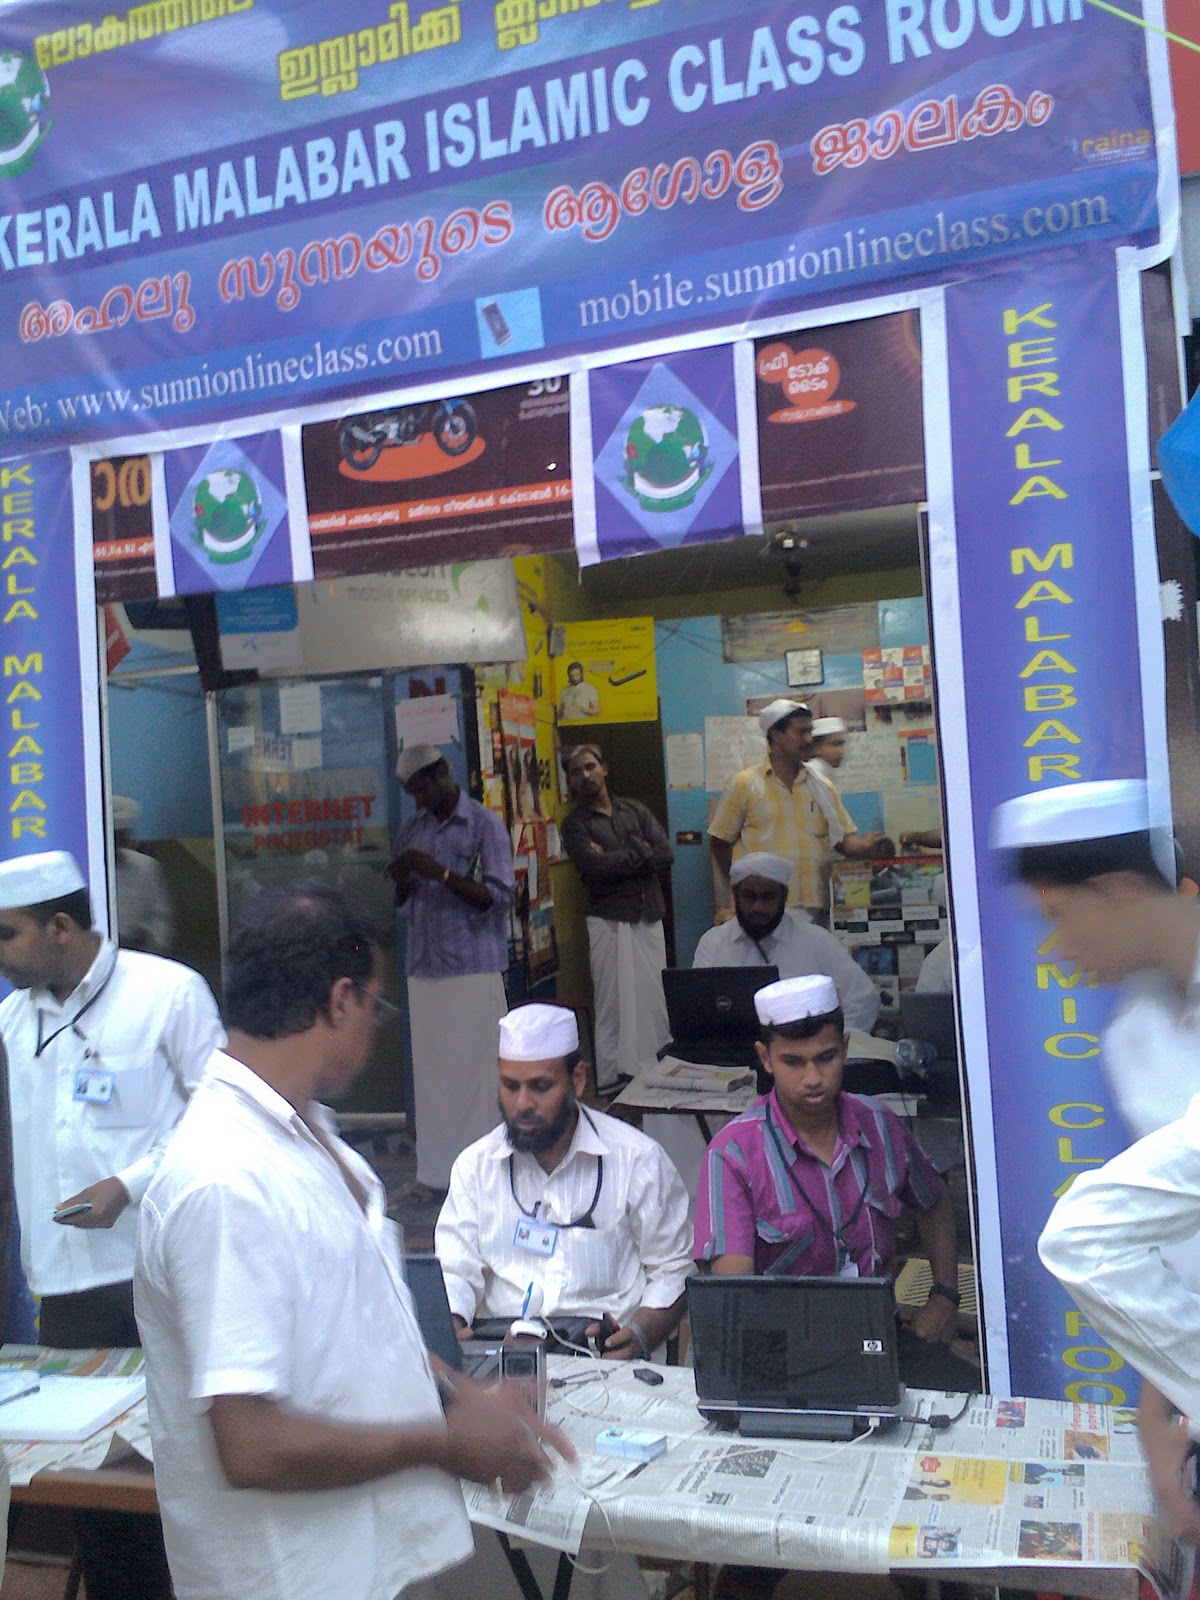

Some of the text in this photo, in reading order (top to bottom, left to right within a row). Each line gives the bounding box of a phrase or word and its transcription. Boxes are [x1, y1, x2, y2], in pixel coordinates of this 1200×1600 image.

[0, 0, 1084, 271] KERALA MALABAR ISLAMIC CLASS ROOM
[543, 140, 784, 243] ആഗോള
[810, 84, 1054, 176] ജാലകം
[579, 194, 1110, 327] mobile.sunnionlineclass.com
[57, 328, 443, 420] www.sunnionlineclass.com
[1003, 302, 1083, 782] KERALA MALABAR
[2, 463, 48, 840] KERALA MALABAR
[242, 795, 375, 828] INTERNET
